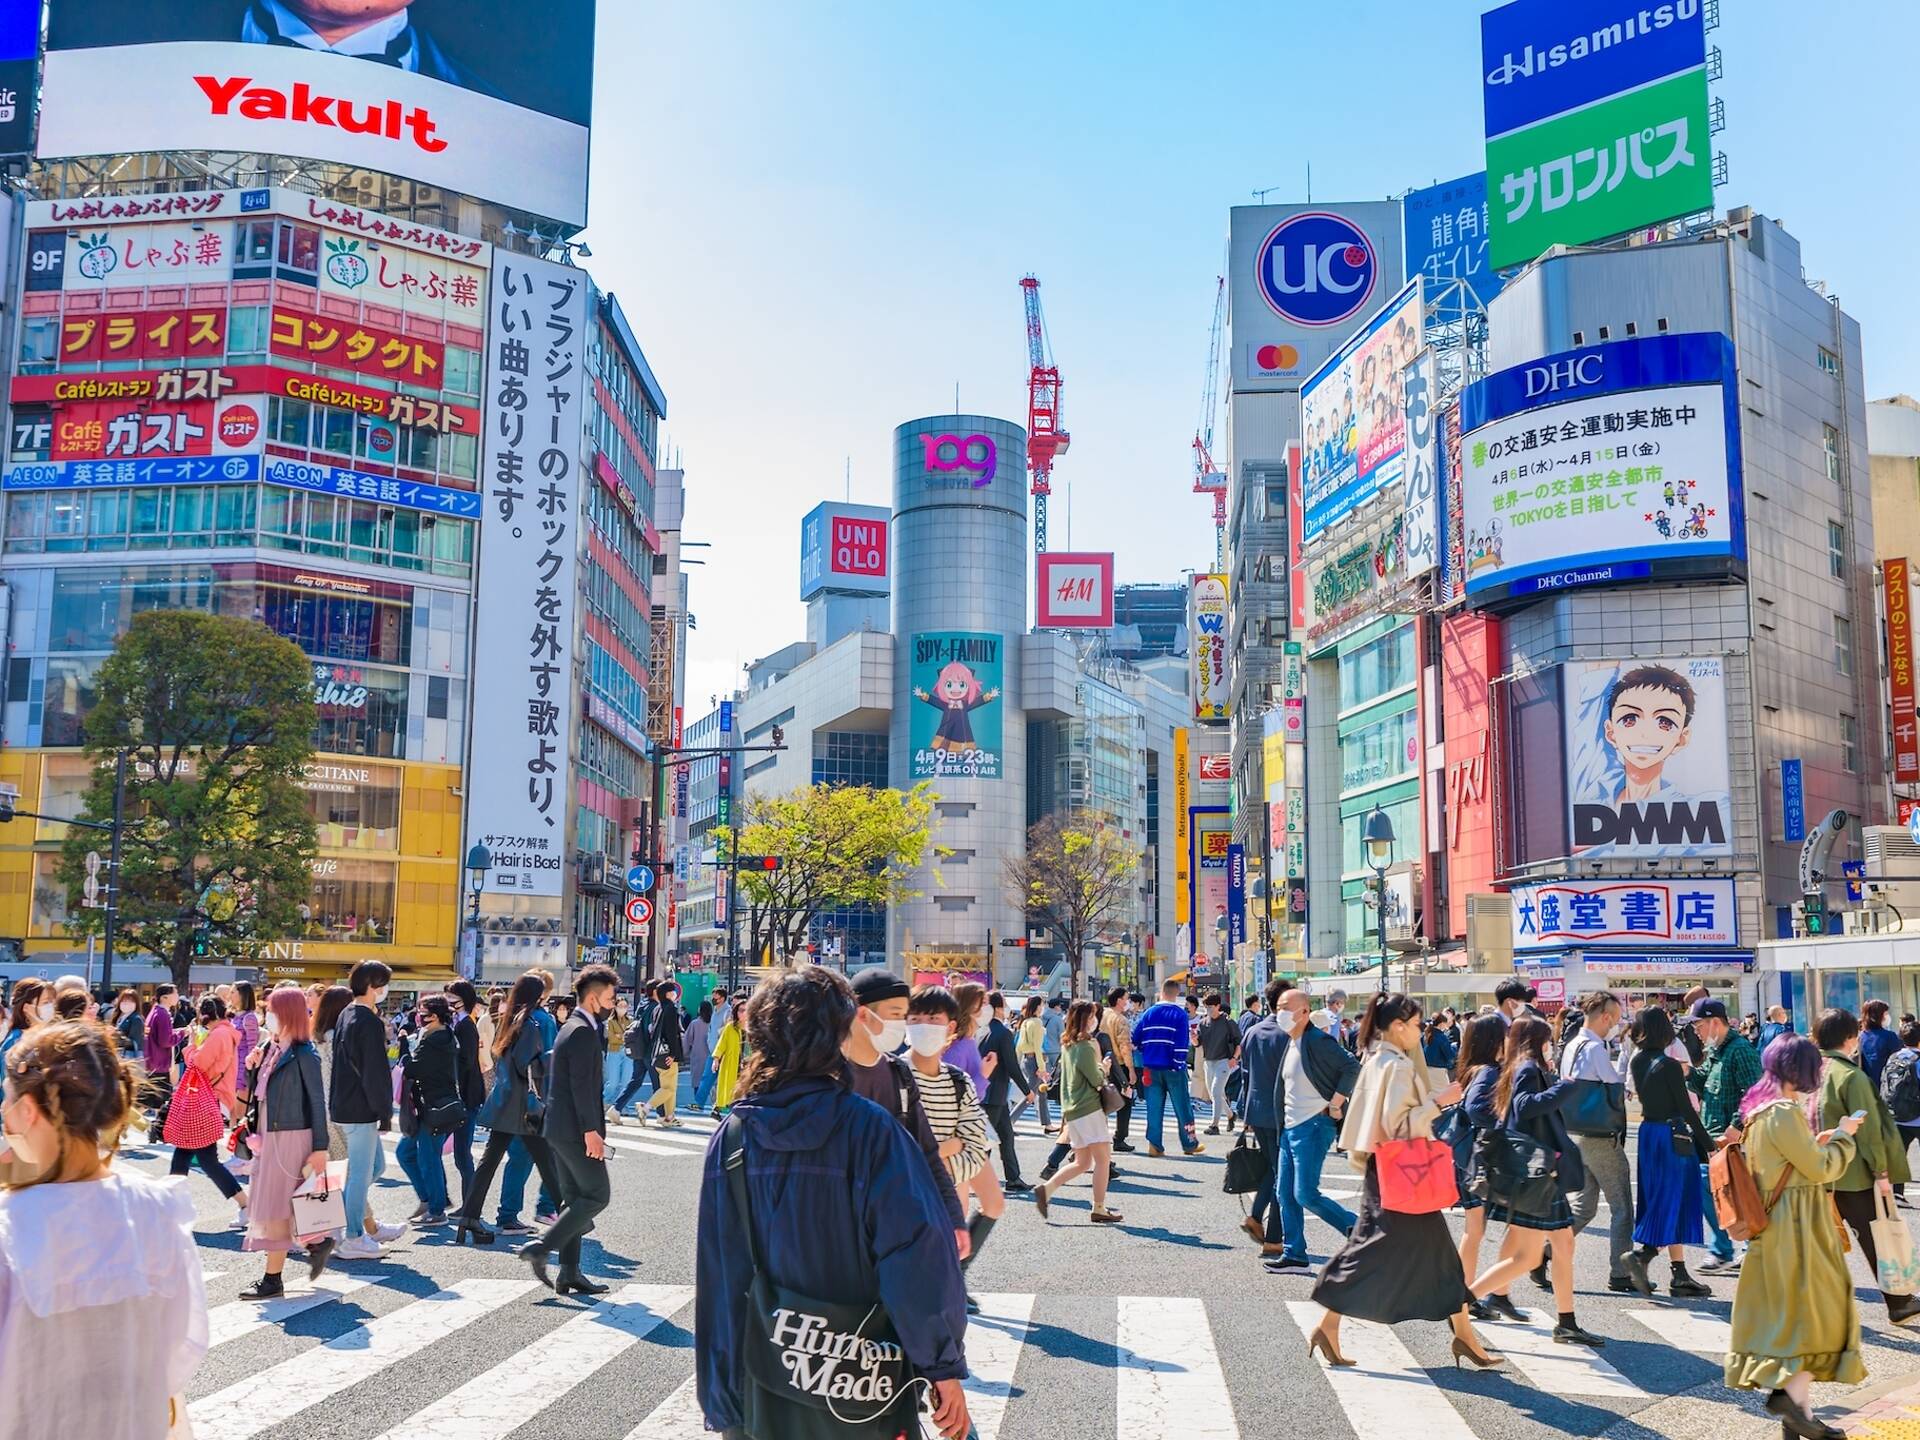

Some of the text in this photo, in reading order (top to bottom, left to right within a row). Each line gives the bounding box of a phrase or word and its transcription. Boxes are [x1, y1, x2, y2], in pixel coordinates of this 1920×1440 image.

[1486, 0, 1699, 86] Hisamitsu
[193, 76, 449, 152] Yakult
[1500, 116, 1696, 224] サロンパス
[51, 193, 225, 222] しゃぶしゃぶバイキング
[243, 192, 268, 208] 寿司
[308, 198, 484, 259] しゃぶしゃぶバイキング
[31, 249, 63, 272] 9F
[124, 232, 223, 269] しゃぶ葉
[377, 255, 480, 308] しゃぶ葉
[64, 312, 221, 353] プライス
[272, 313, 438, 376] コンタクト
[155, 368, 235, 402] ガスト
[1525, 353, 1603, 399] DHC
[387, 395, 464, 434] ガスト
[492, 265, 534, 539] いい曲あります。
[15, 423, 52, 449] 7F
[59, 439, 101, 452] レストラン
[60, 419, 103, 441] Café
[105, 412, 205, 456] ガスト
[222, 423, 256, 436] ガスト
[1471, 405, 1697, 469] 春の交通安全運動実施中
[12, 460, 247, 485] AEON 英会話イーオン 6F
[919, 432, 998, 488] 109
[1405, 364, 1434, 564] もんじゃ
[273, 461, 478, 512] AEON 英会話イーオン
[1492, 465, 1664, 513] 世界一の交通安全都市
[1509, 491, 1639, 528] TOKYOを目指して
[527, 278, 578, 828] ブラジャーのホックを外す歌より、
[838, 523, 877, 547] UNI
[837, 546, 881, 570] QLO
[1056, 576, 1095, 603] H&M
[1537, 568, 1613, 590] DHC Channel
[1888, 564, 1919, 772] クスリのことなら 三千里
[307, 681, 369, 709] shi8
[915, 765, 997, 776] テレビ東京系 ON AIR
[1785, 764, 1803, 839] 大盛堂商事ビル
[484, 834, 549, 850] サブスク解禁
[1572, 800, 1727, 847] DMM
[494, 852, 561, 870] Hair is Bad
[1208, 833, 1231, 854] 薬
[1232, 853, 1242, 888] MIZUHO
[1519, 890, 1715, 935] 大盛堂書店
[1676, 932, 1728, 941] BOOKS TAISEIDO
[769, 1308, 904, 1371] Human
[781, 1349, 894, 1403] Made
